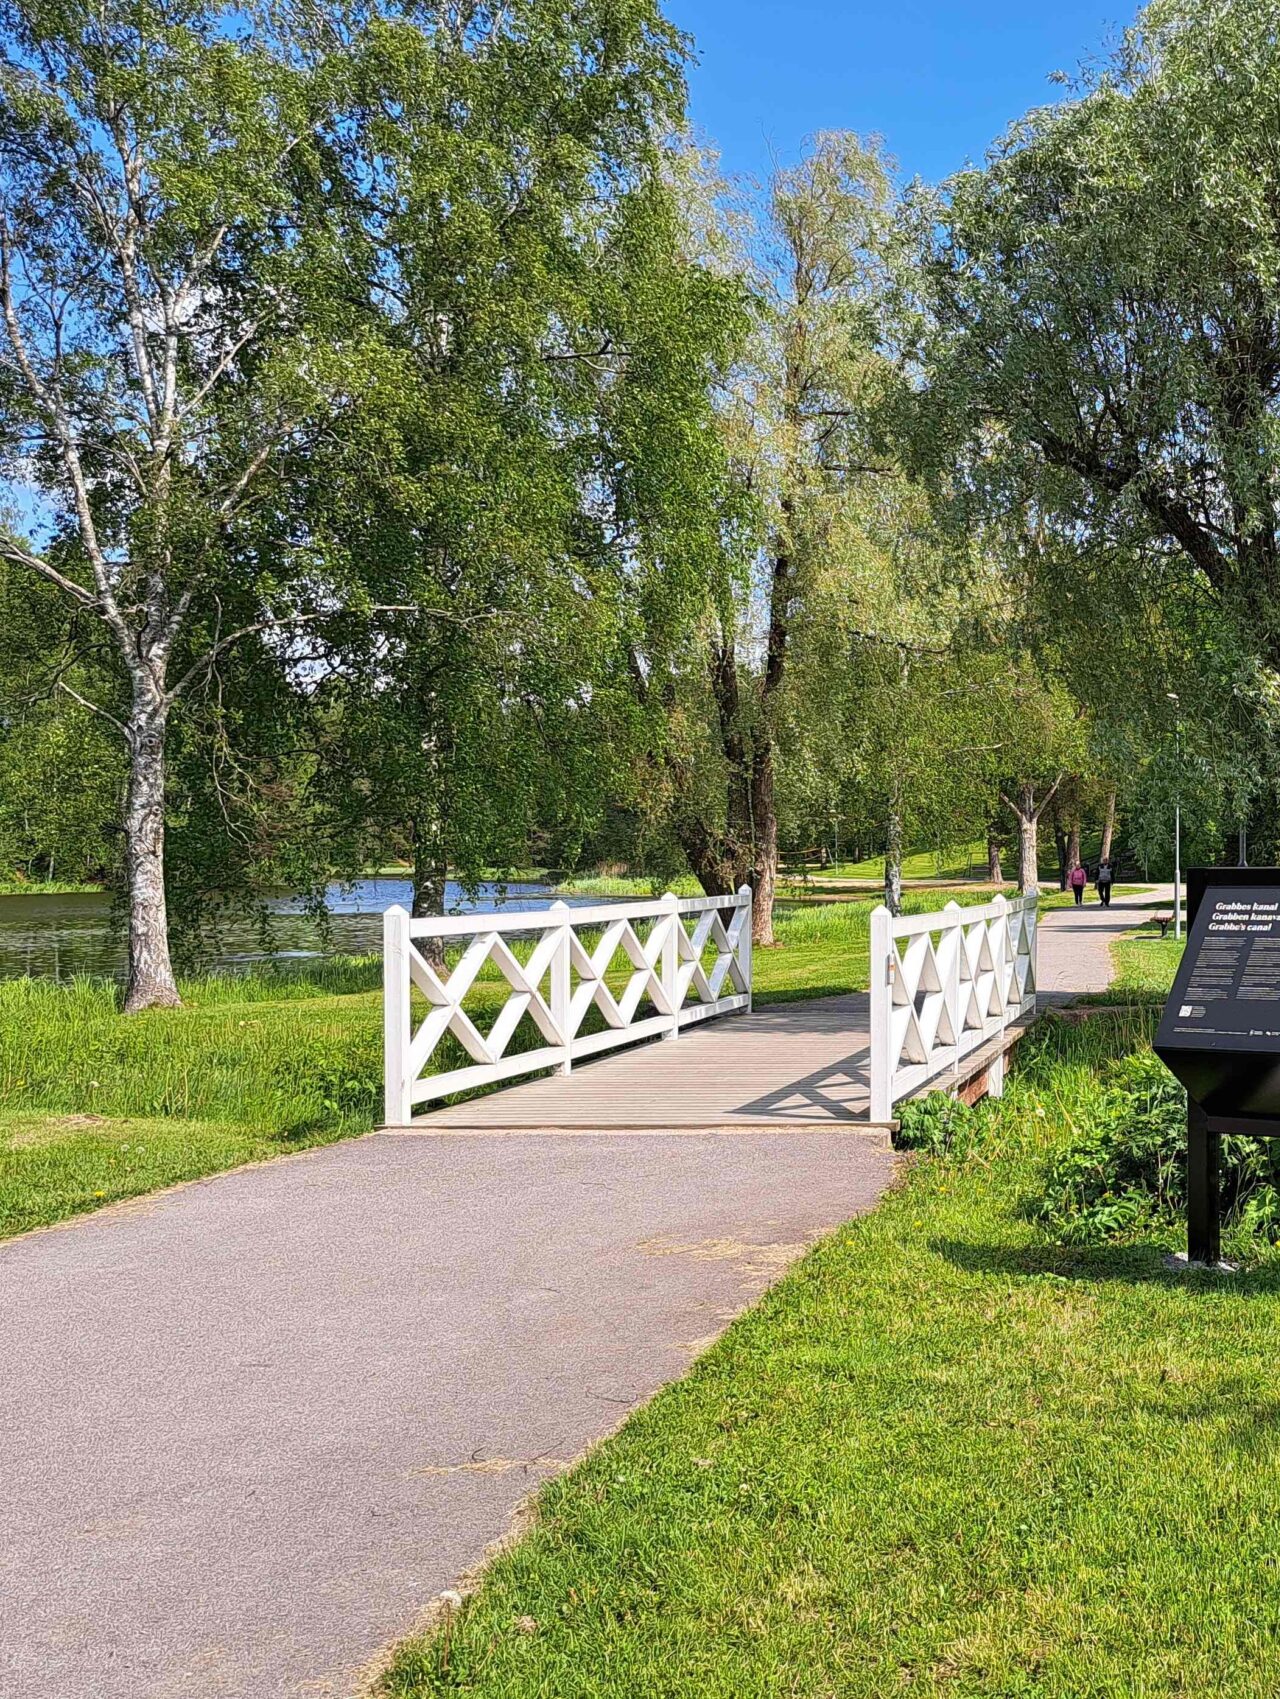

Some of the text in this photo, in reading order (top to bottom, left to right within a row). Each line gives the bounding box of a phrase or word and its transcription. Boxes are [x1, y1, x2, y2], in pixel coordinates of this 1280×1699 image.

[1215, 902, 1279, 911] Grabbes kanal
[1212, 912, 1249, 921] Grabben
[1208, 922, 1272, 931] Grabbe's canal
